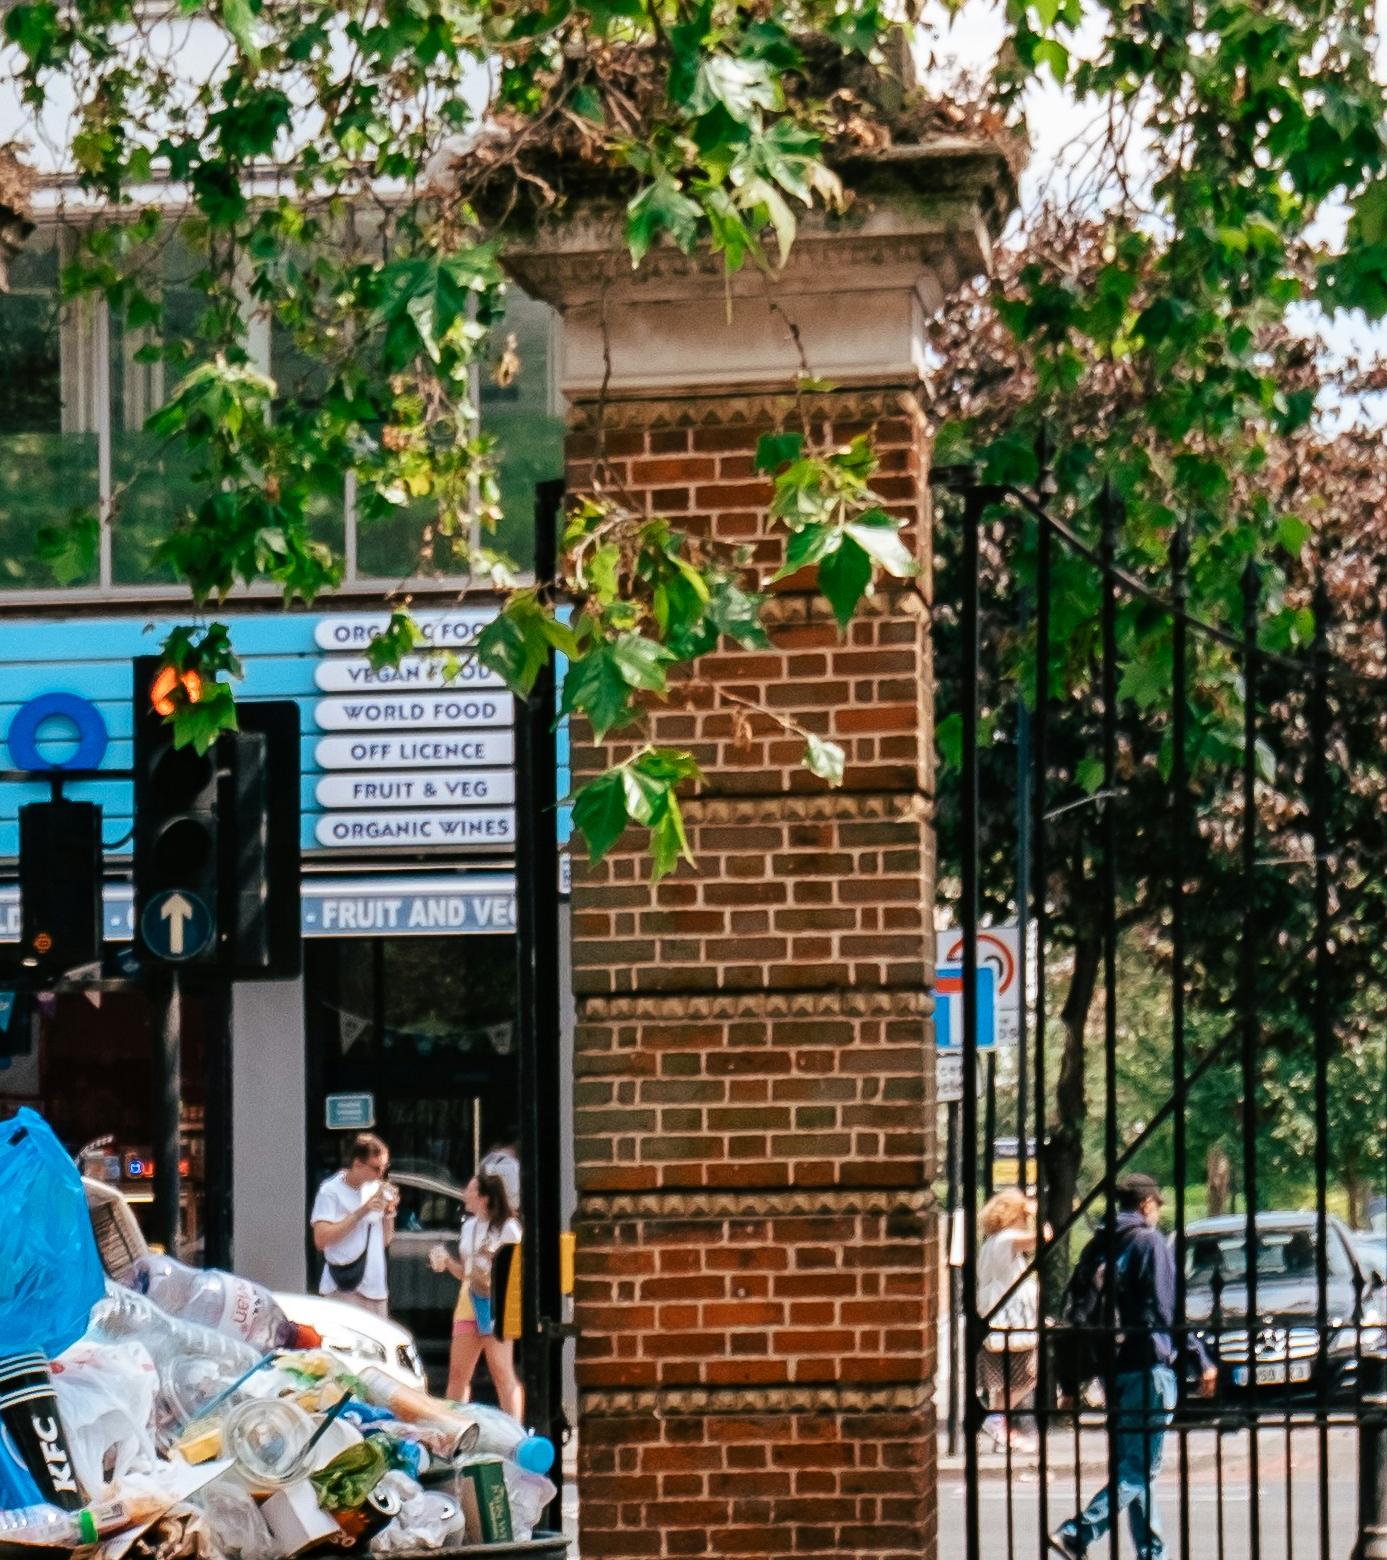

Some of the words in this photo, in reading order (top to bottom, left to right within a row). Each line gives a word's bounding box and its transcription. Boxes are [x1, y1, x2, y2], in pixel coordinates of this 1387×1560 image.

[334, 623, 433, 642] ORGC
[343, 704, 424, 721] WORLD
[433, 702, 496, 719] FOOD
[351, 744, 391, 761] OFF
[400, 743, 485, 760] LICENCE
[353, 782, 415, 799] FRUIT
[423, 782, 438, 798] &
[445, 781, 488, 798] VEG
[332, 821, 433, 839] ORGANIC
[439, 819, 509, 837] WINES
[322, 900, 401, 929] FRUIT
[407, 897, 466, 927] AND
[31, 1413, 78, 1493] KFC
